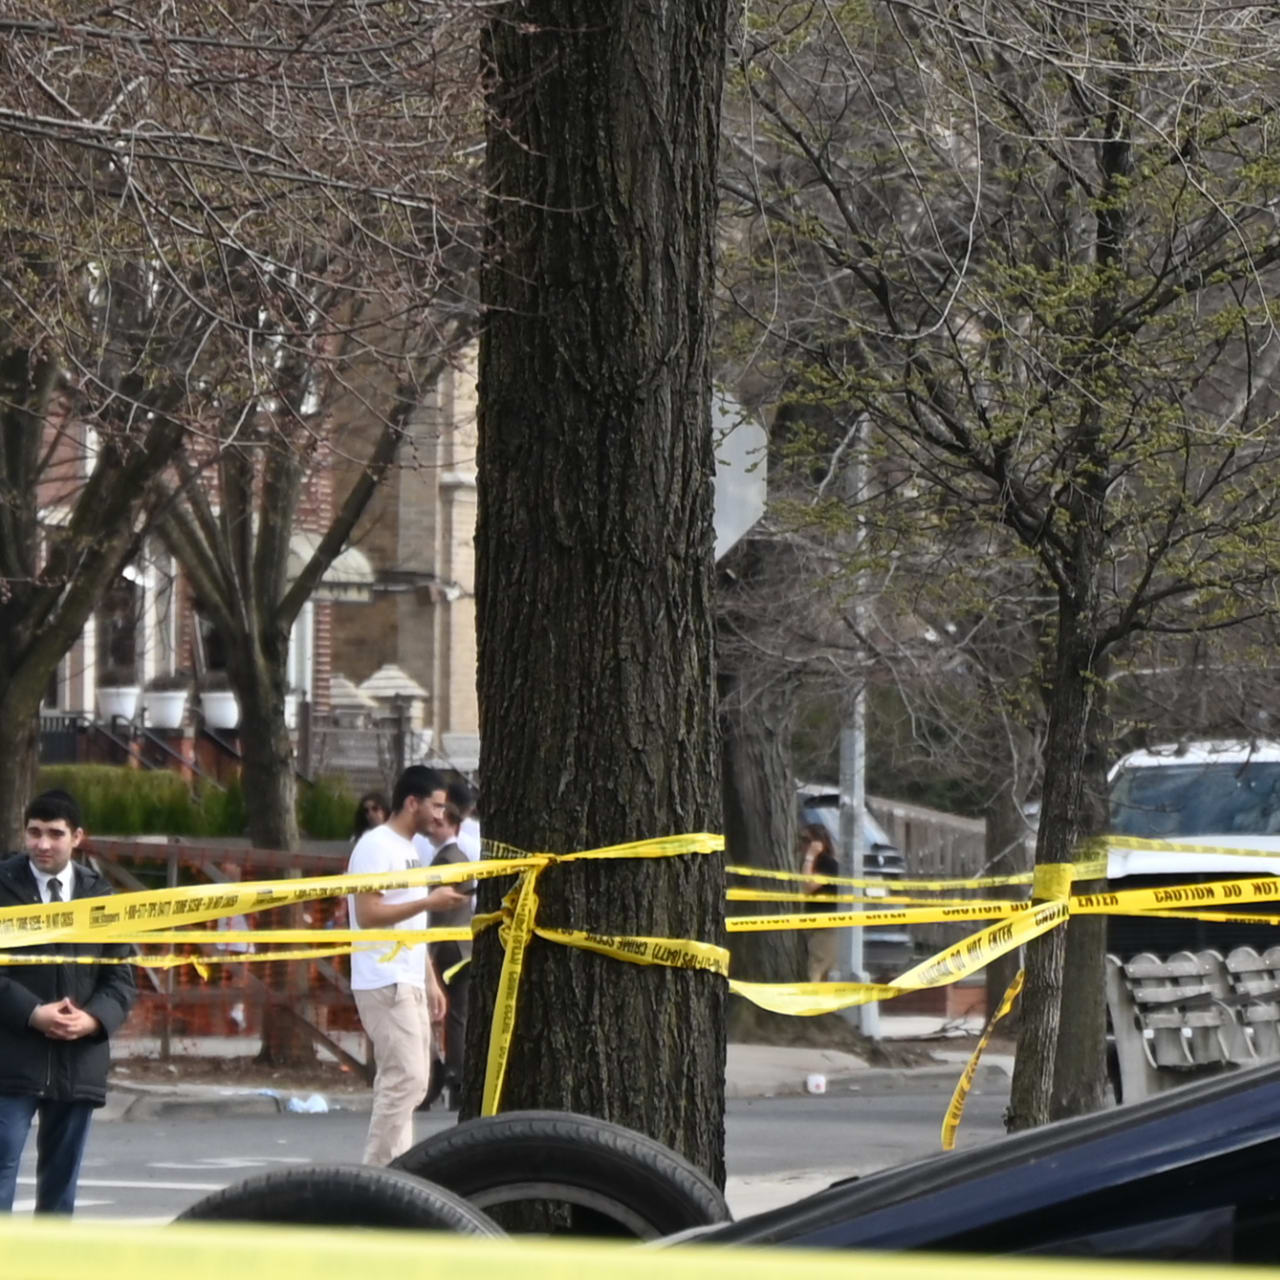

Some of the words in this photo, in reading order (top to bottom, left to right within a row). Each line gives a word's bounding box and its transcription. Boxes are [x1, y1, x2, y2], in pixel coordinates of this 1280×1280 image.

[1154, 887, 1215, 903] CAUTION
[1222, 885, 1242, 898] DO
[1252, 881, 1278, 895] NOT
[988, 924, 1013, 950] ENTER
